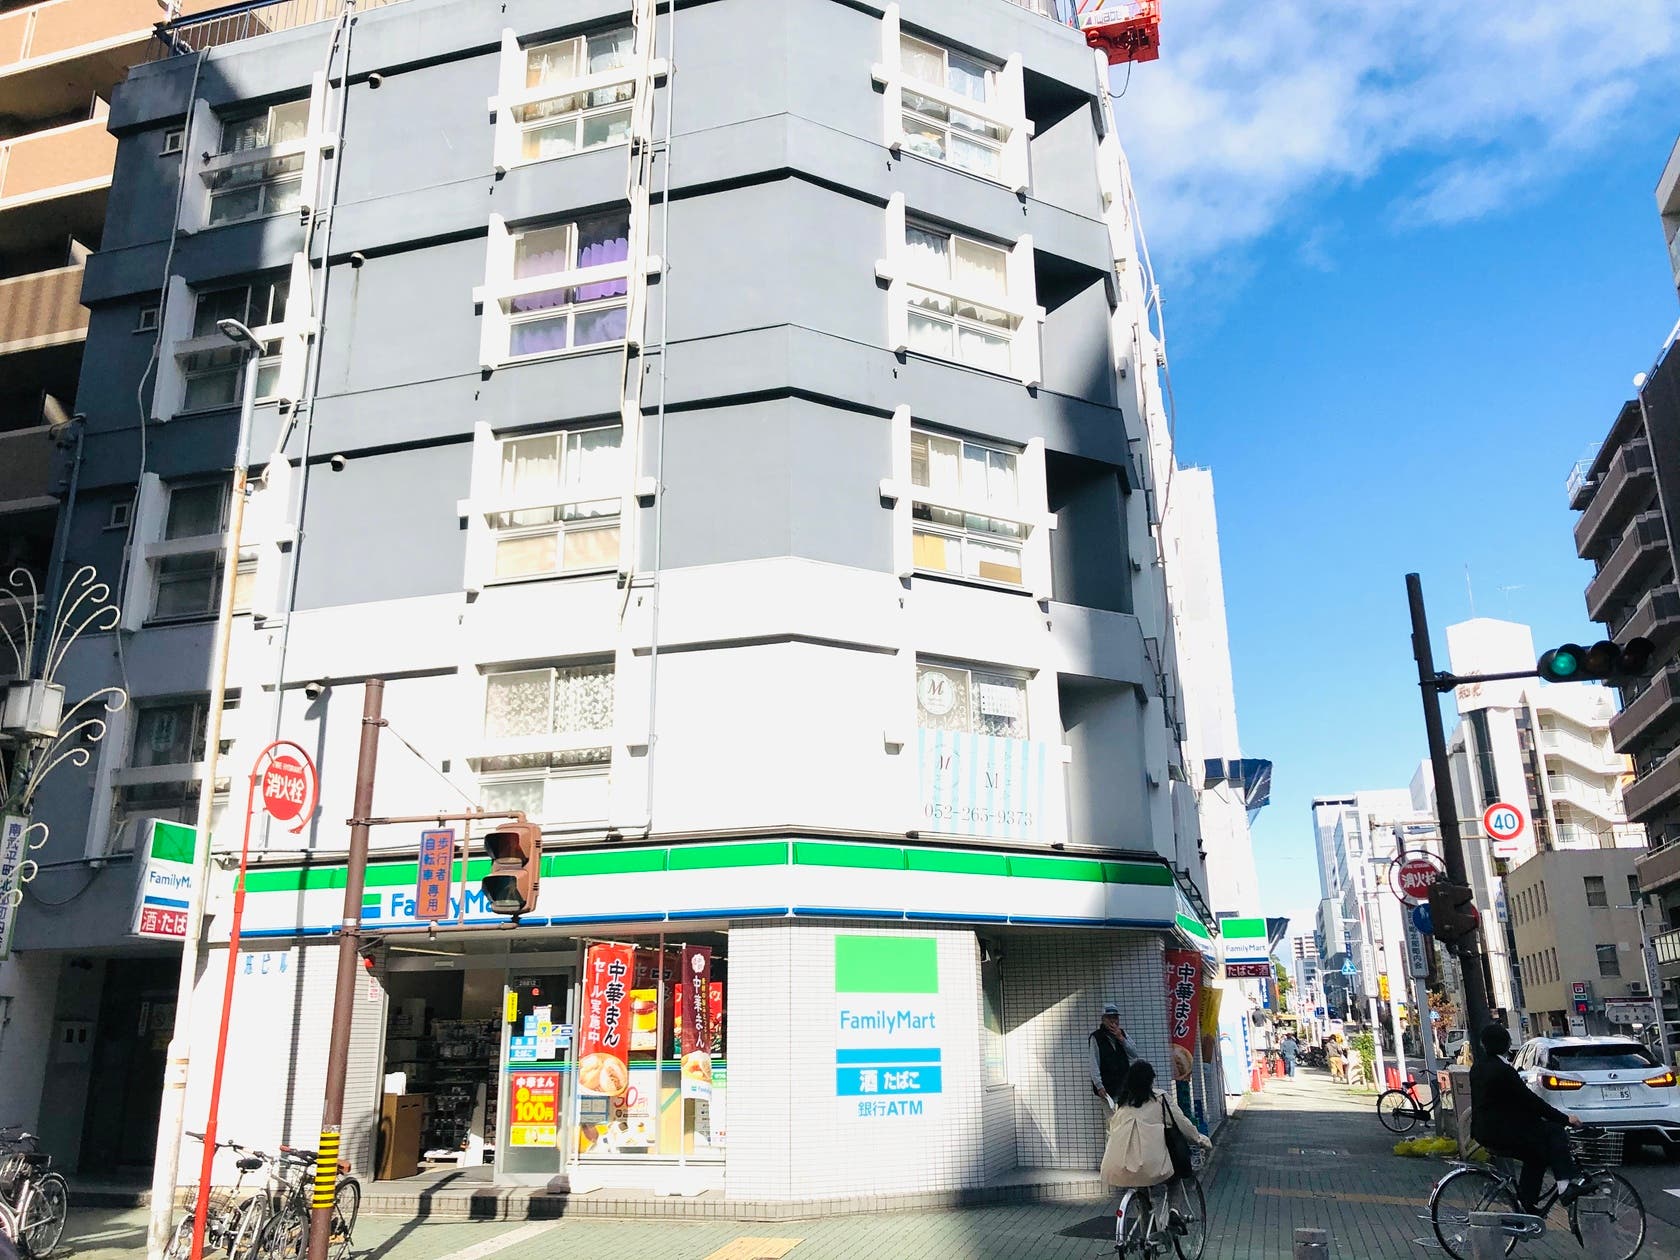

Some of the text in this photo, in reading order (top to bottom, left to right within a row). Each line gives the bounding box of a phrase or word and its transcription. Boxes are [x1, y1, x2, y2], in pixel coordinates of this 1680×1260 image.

[266, 772, 304, 804] 消火栓
[1494, 813, 1516, 830] 40
[423, 838, 436, 881] 自転車
[436, 838, 450, 881] 歩行者
[150, 871, 192, 890] FamilyM
[427, 884, 439, 912] 専用
[1225, 944, 1267, 954] FamilyMart
[587, 957, 606, 1045] セール実施中
[602, 958, 627, 1049] 中華まん
[692, 975, 706, 1049] 中華まん
[1173, 962, 1196, 1039] 中華まん
[840, 1010, 936, 1034] FamilyMart
[859, 1069, 921, 1092] 酒 たばこ
[515, 1102, 554, 1121] 100円
[858, 1100, 923, 1117] 銀行ATM
